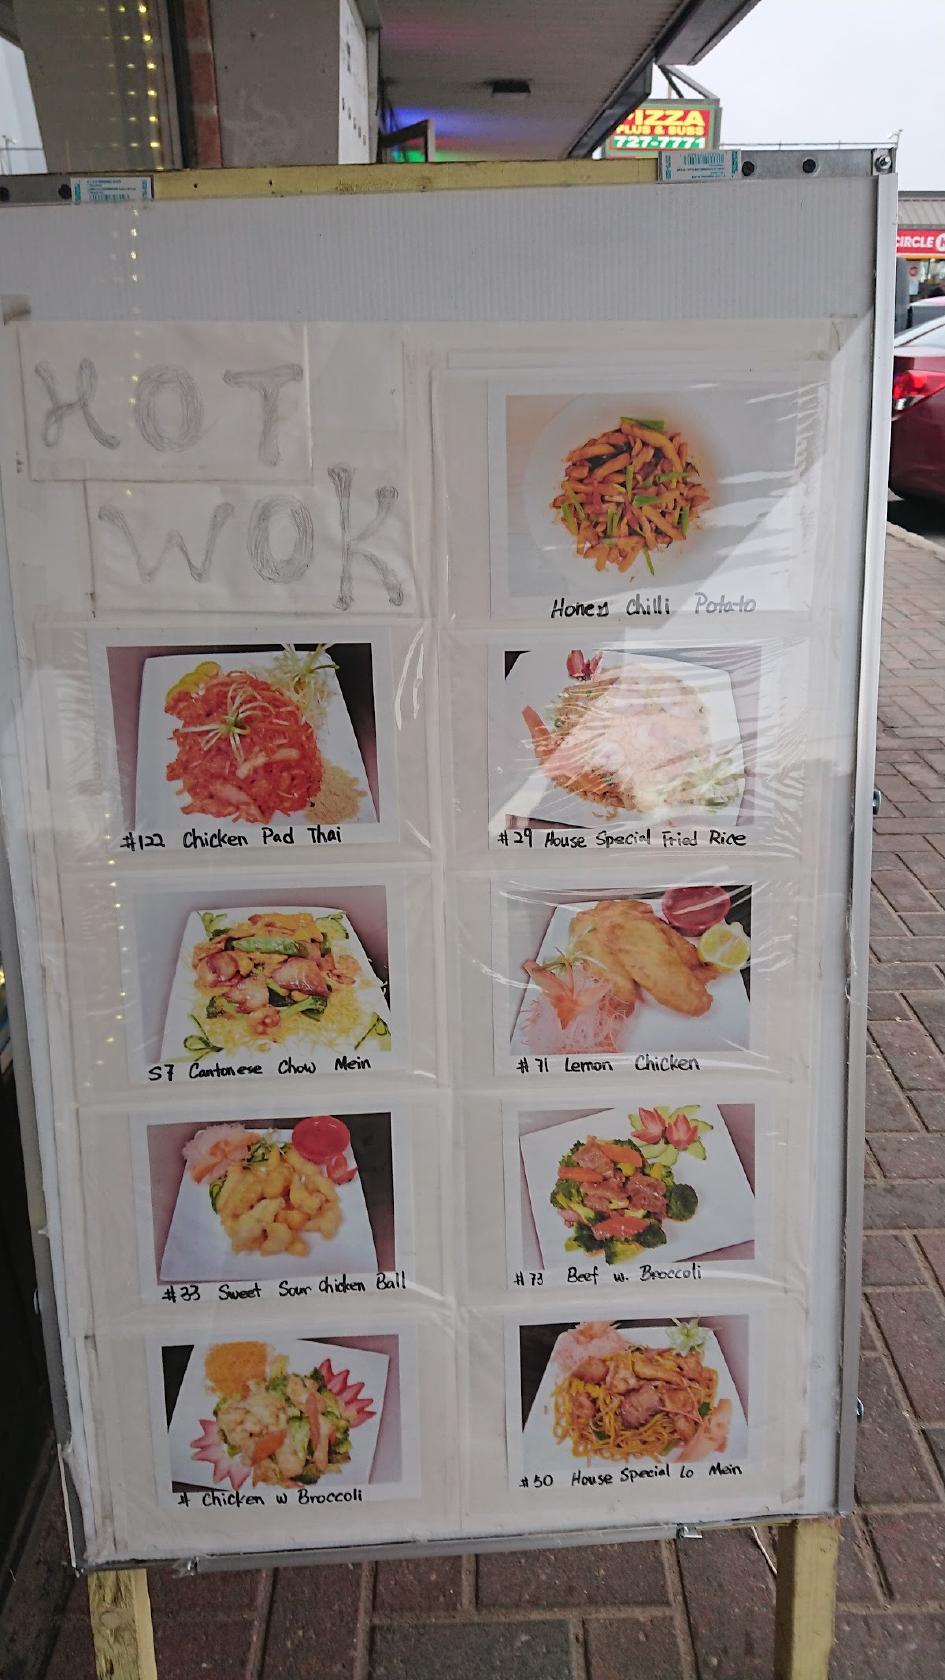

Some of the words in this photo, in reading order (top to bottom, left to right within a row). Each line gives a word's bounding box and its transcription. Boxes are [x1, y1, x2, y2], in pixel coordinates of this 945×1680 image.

[613, 135, 706, 149] 727-7771
[654, 126, 666, 135] &
[35, 357, 303, 467] HOT
[98, 462, 404, 611] WOK
[694, 591, 757, 615] Potato
[119, 831, 166, 851] #122
[182, 827, 249, 849] Chicken
[261, 826, 295, 845] Pad
[307, 825, 342, 844] Thai
[544, 830, 588, 848] House
[595, 828, 651, 848] Special
[662, 830, 699, 847] Fried
[709, 829, 747, 846] Rice
[188, 1062, 264, 1080] Cantonese
[278, 1056, 317, 1075] Chow
[334, 1055, 372, 1071] Mein
[564, 1057, 614, 1072] Lemon
[634, 1053, 701, 1072] Chicken
[218, 1282, 262, 1301] Sweet
[278, 1280, 313, 1297] Sour
[376, 1270, 407, 1290] Ball
[567, 1266, 599, 1285] Beef
[639, 1262, 702, 1281] Broccoli
[571, 1469, 613, 1486] House
[619, 1463, 671, 1484] Special
[708, 1462, 743, 1476] Mein
[202, 1490, 265, 1507] Chicken
[297, 1488, 363, 1505] Broccoli
